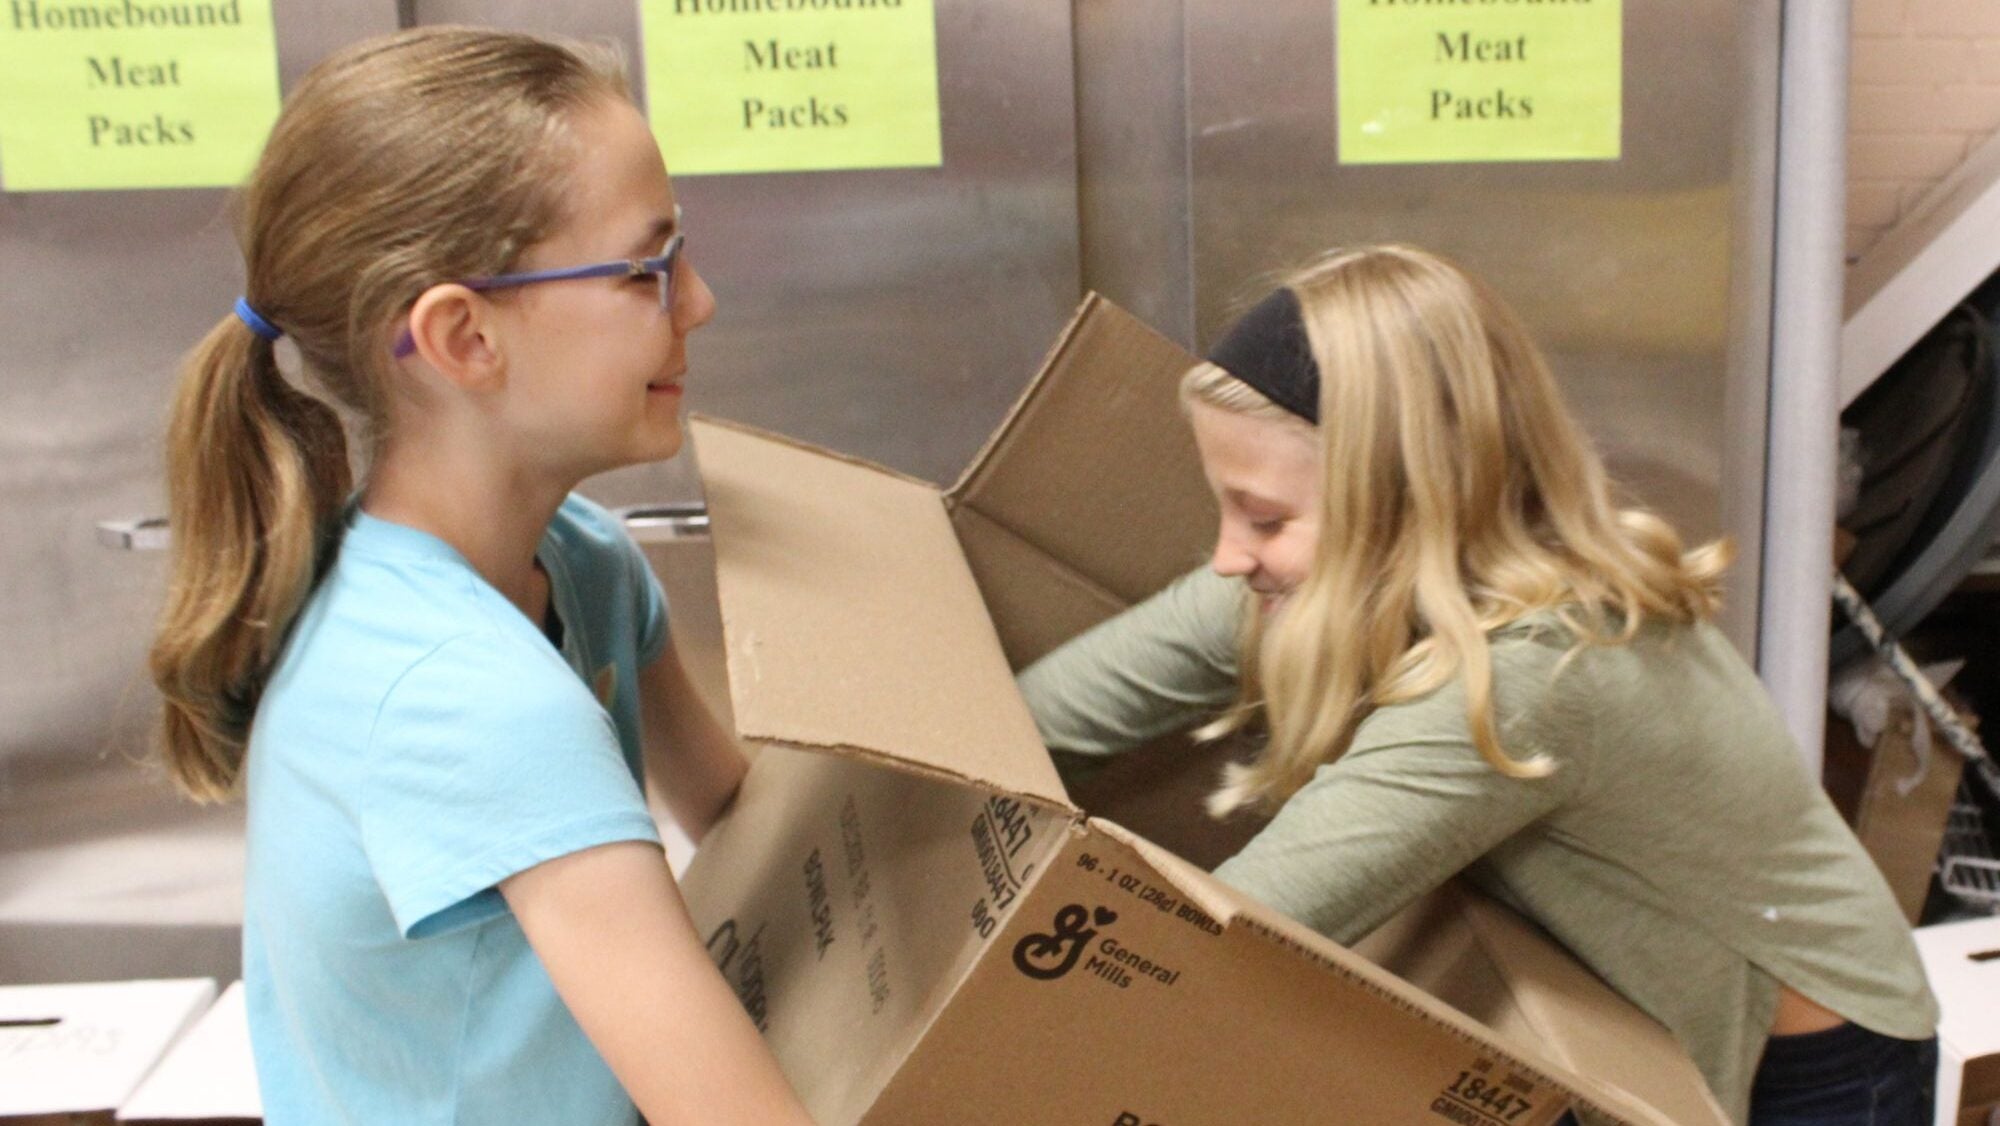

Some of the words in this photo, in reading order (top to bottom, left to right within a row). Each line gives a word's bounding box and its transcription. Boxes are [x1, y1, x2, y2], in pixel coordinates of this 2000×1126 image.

[11, 0, 241, 29] Homebound
[744, 40, 839, 70] Meat
[1436, 31, 1527, 63] Meat
[86, 56, 181, 88] Meat
[741, 97, 849, 130] Packs
[1430, 88, 1534, 121] Packs
[87, 115, 195, 147] Packs
[1076, 852, 1098, 872] 96
[1106, 868, 1119, 882] 1
[1119, 874, 1142, 893] OZ
[1175, 903, 1224, 937] BOWLS
[1083, 954, 1133, 989] Mills
[1099, 936, 1181, 987] General
[1448, 1070, 1532, 1121] 18447
